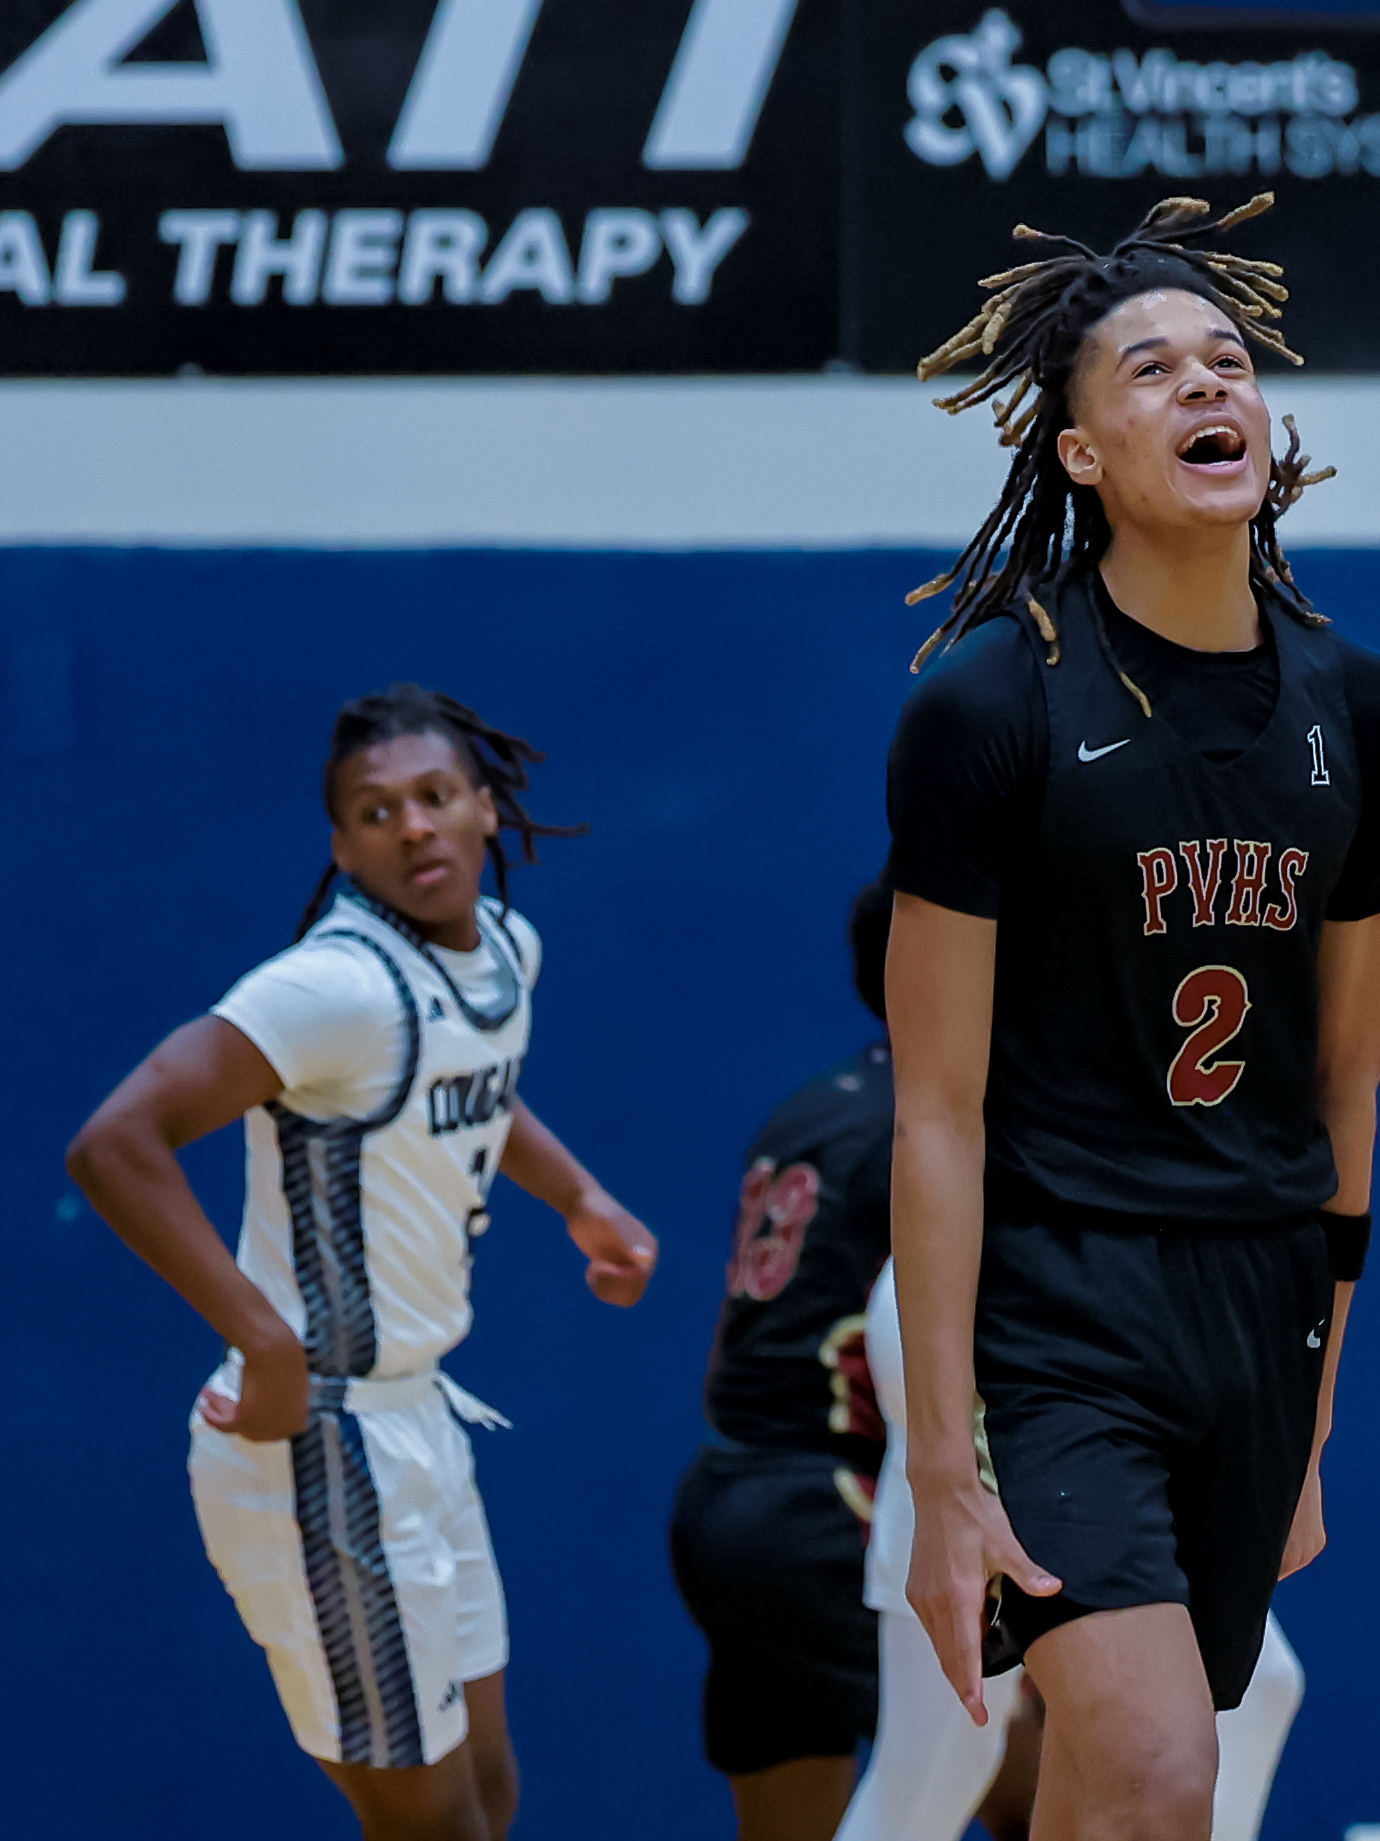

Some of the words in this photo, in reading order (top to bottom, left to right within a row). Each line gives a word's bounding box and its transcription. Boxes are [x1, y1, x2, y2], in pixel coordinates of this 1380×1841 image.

[1046, 116, 1281, 178] HEALTH
[158, 208, 750, 306] THERAPY
[1306, 725, 1331, 786] 1
[1136, 838, 1310, 936] PVHS
[1166, 964, 1253, 1107] 2
